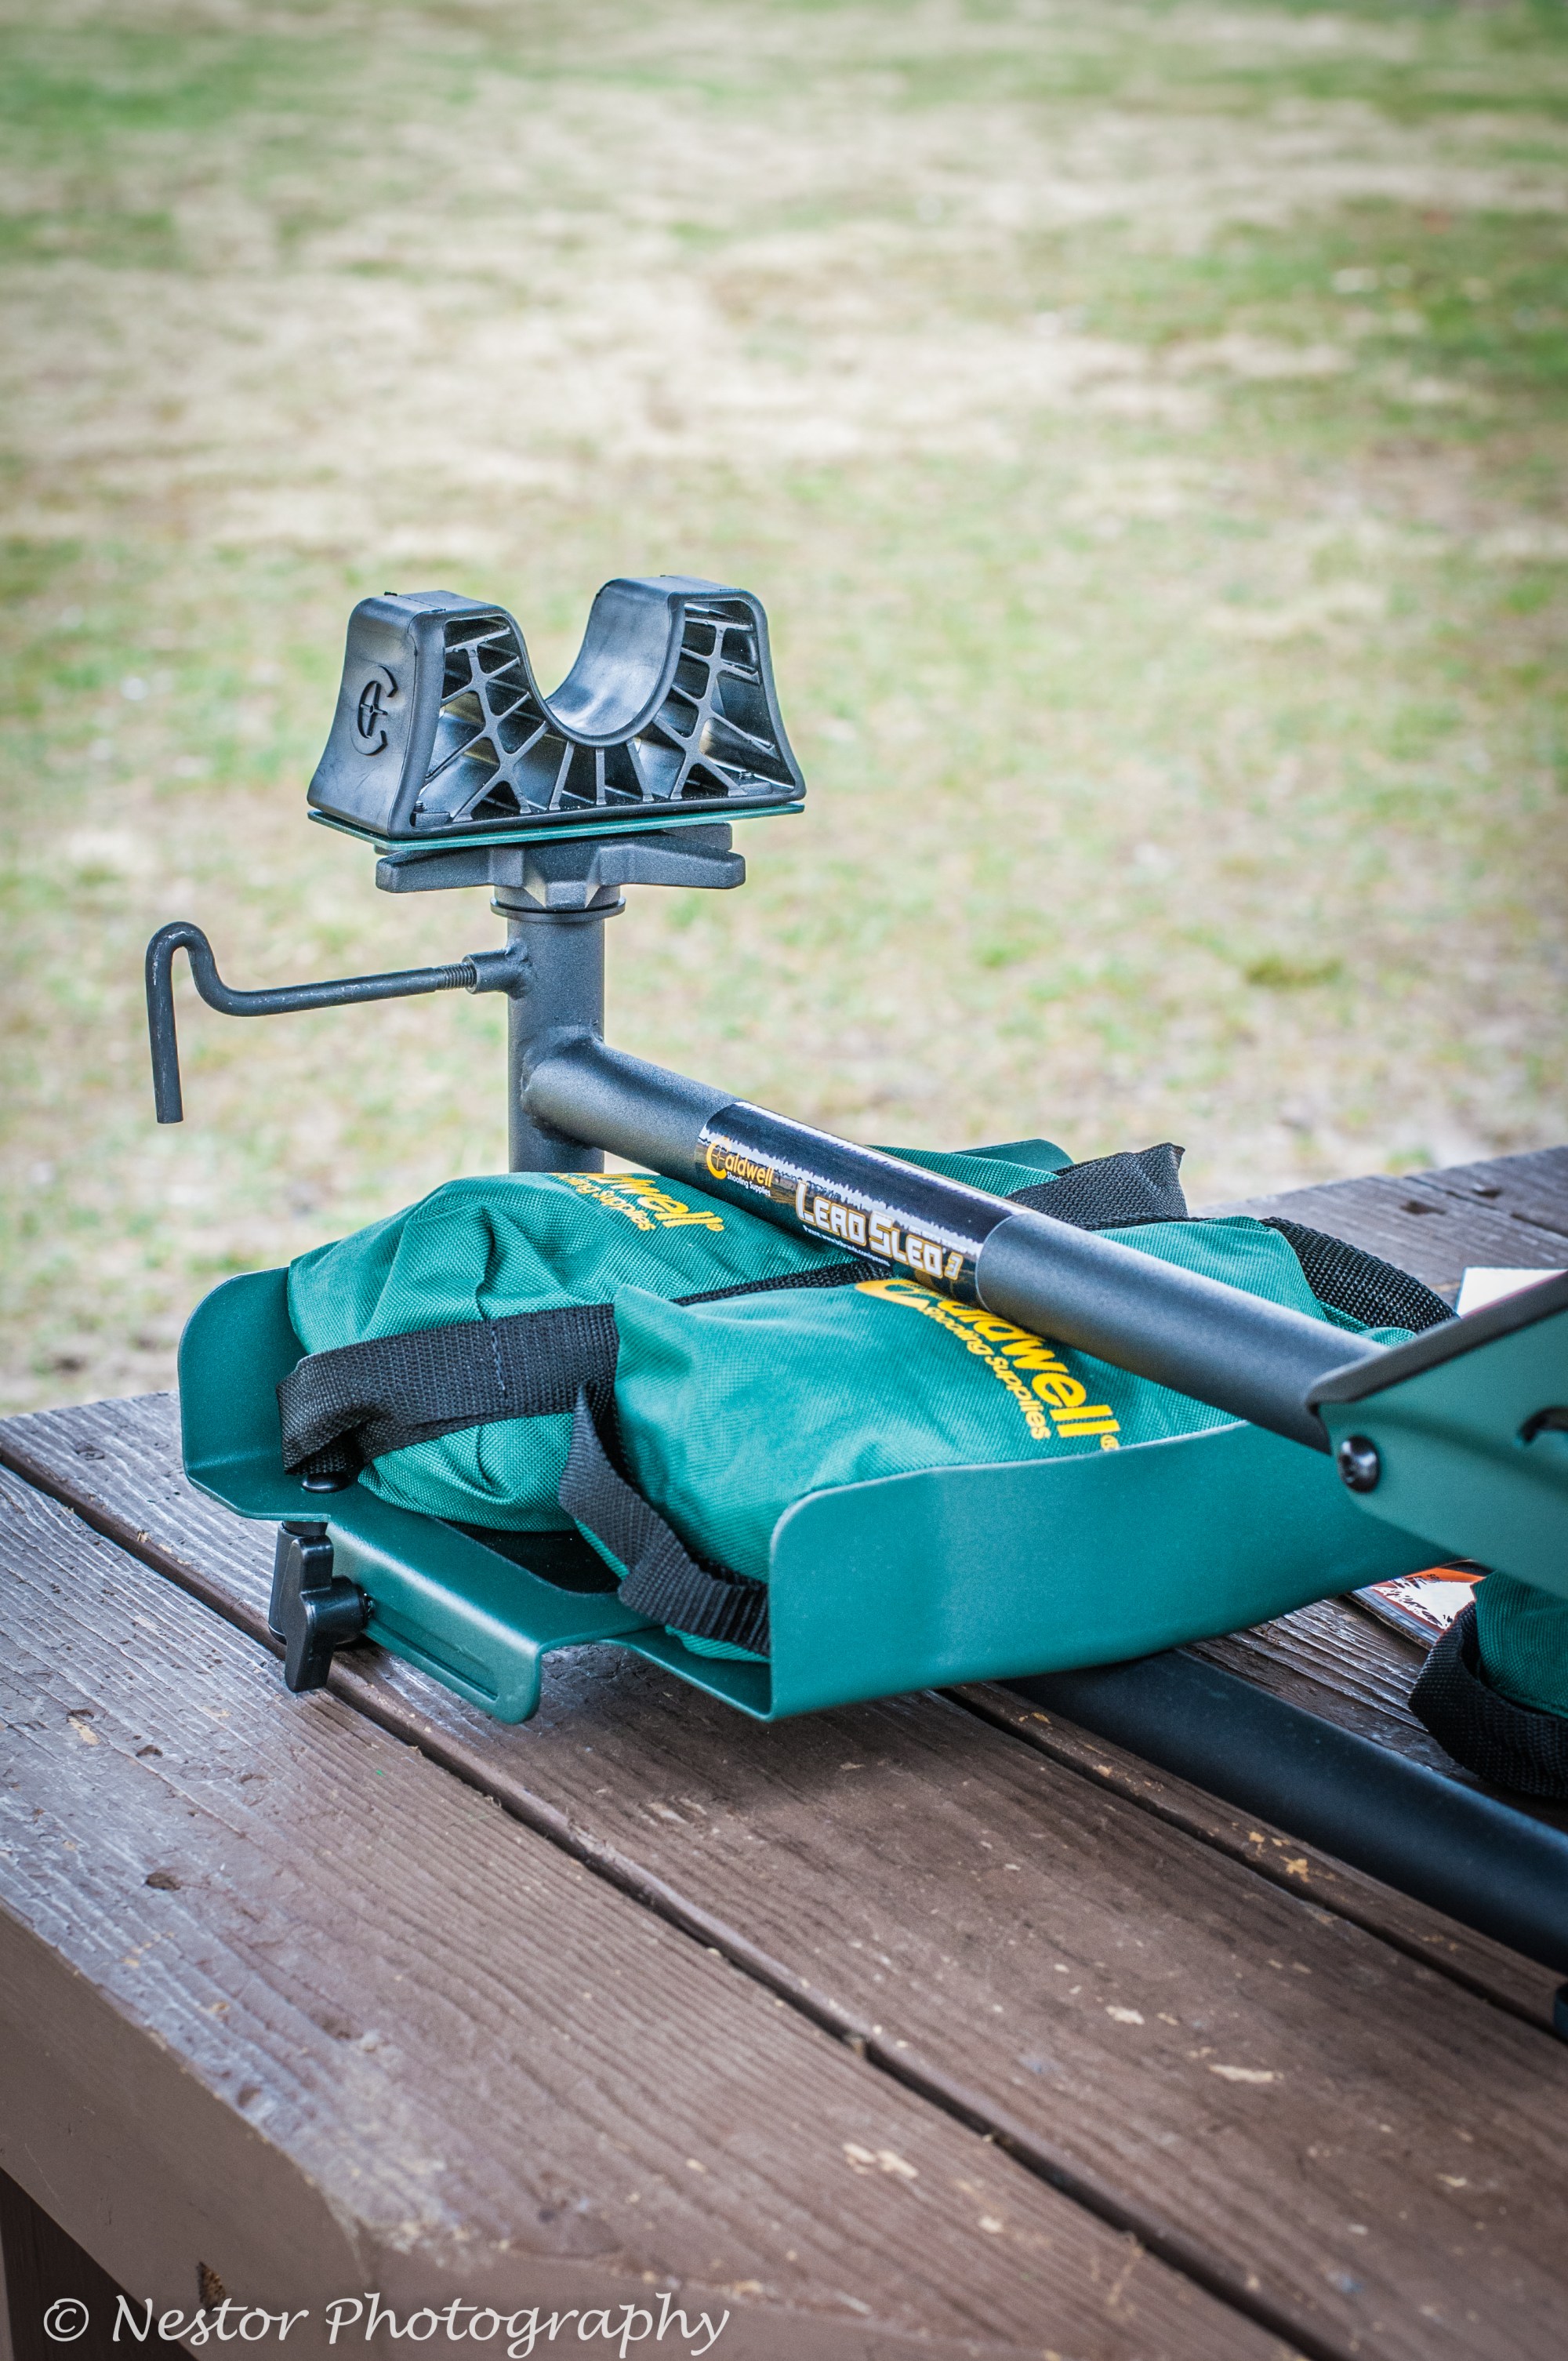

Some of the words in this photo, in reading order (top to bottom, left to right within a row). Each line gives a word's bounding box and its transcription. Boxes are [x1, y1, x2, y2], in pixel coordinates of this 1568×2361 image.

[706, 1135, 774, 1187] Caldwell
[727, 1171, 749, 1189] Shooting
[750, 1180, 771, 1197] Supplies
[796, 1179, 866, 1247] LEAD
[869, 1210, 943, 1279] SLED
[944, 1251, 964, 1280] 3
